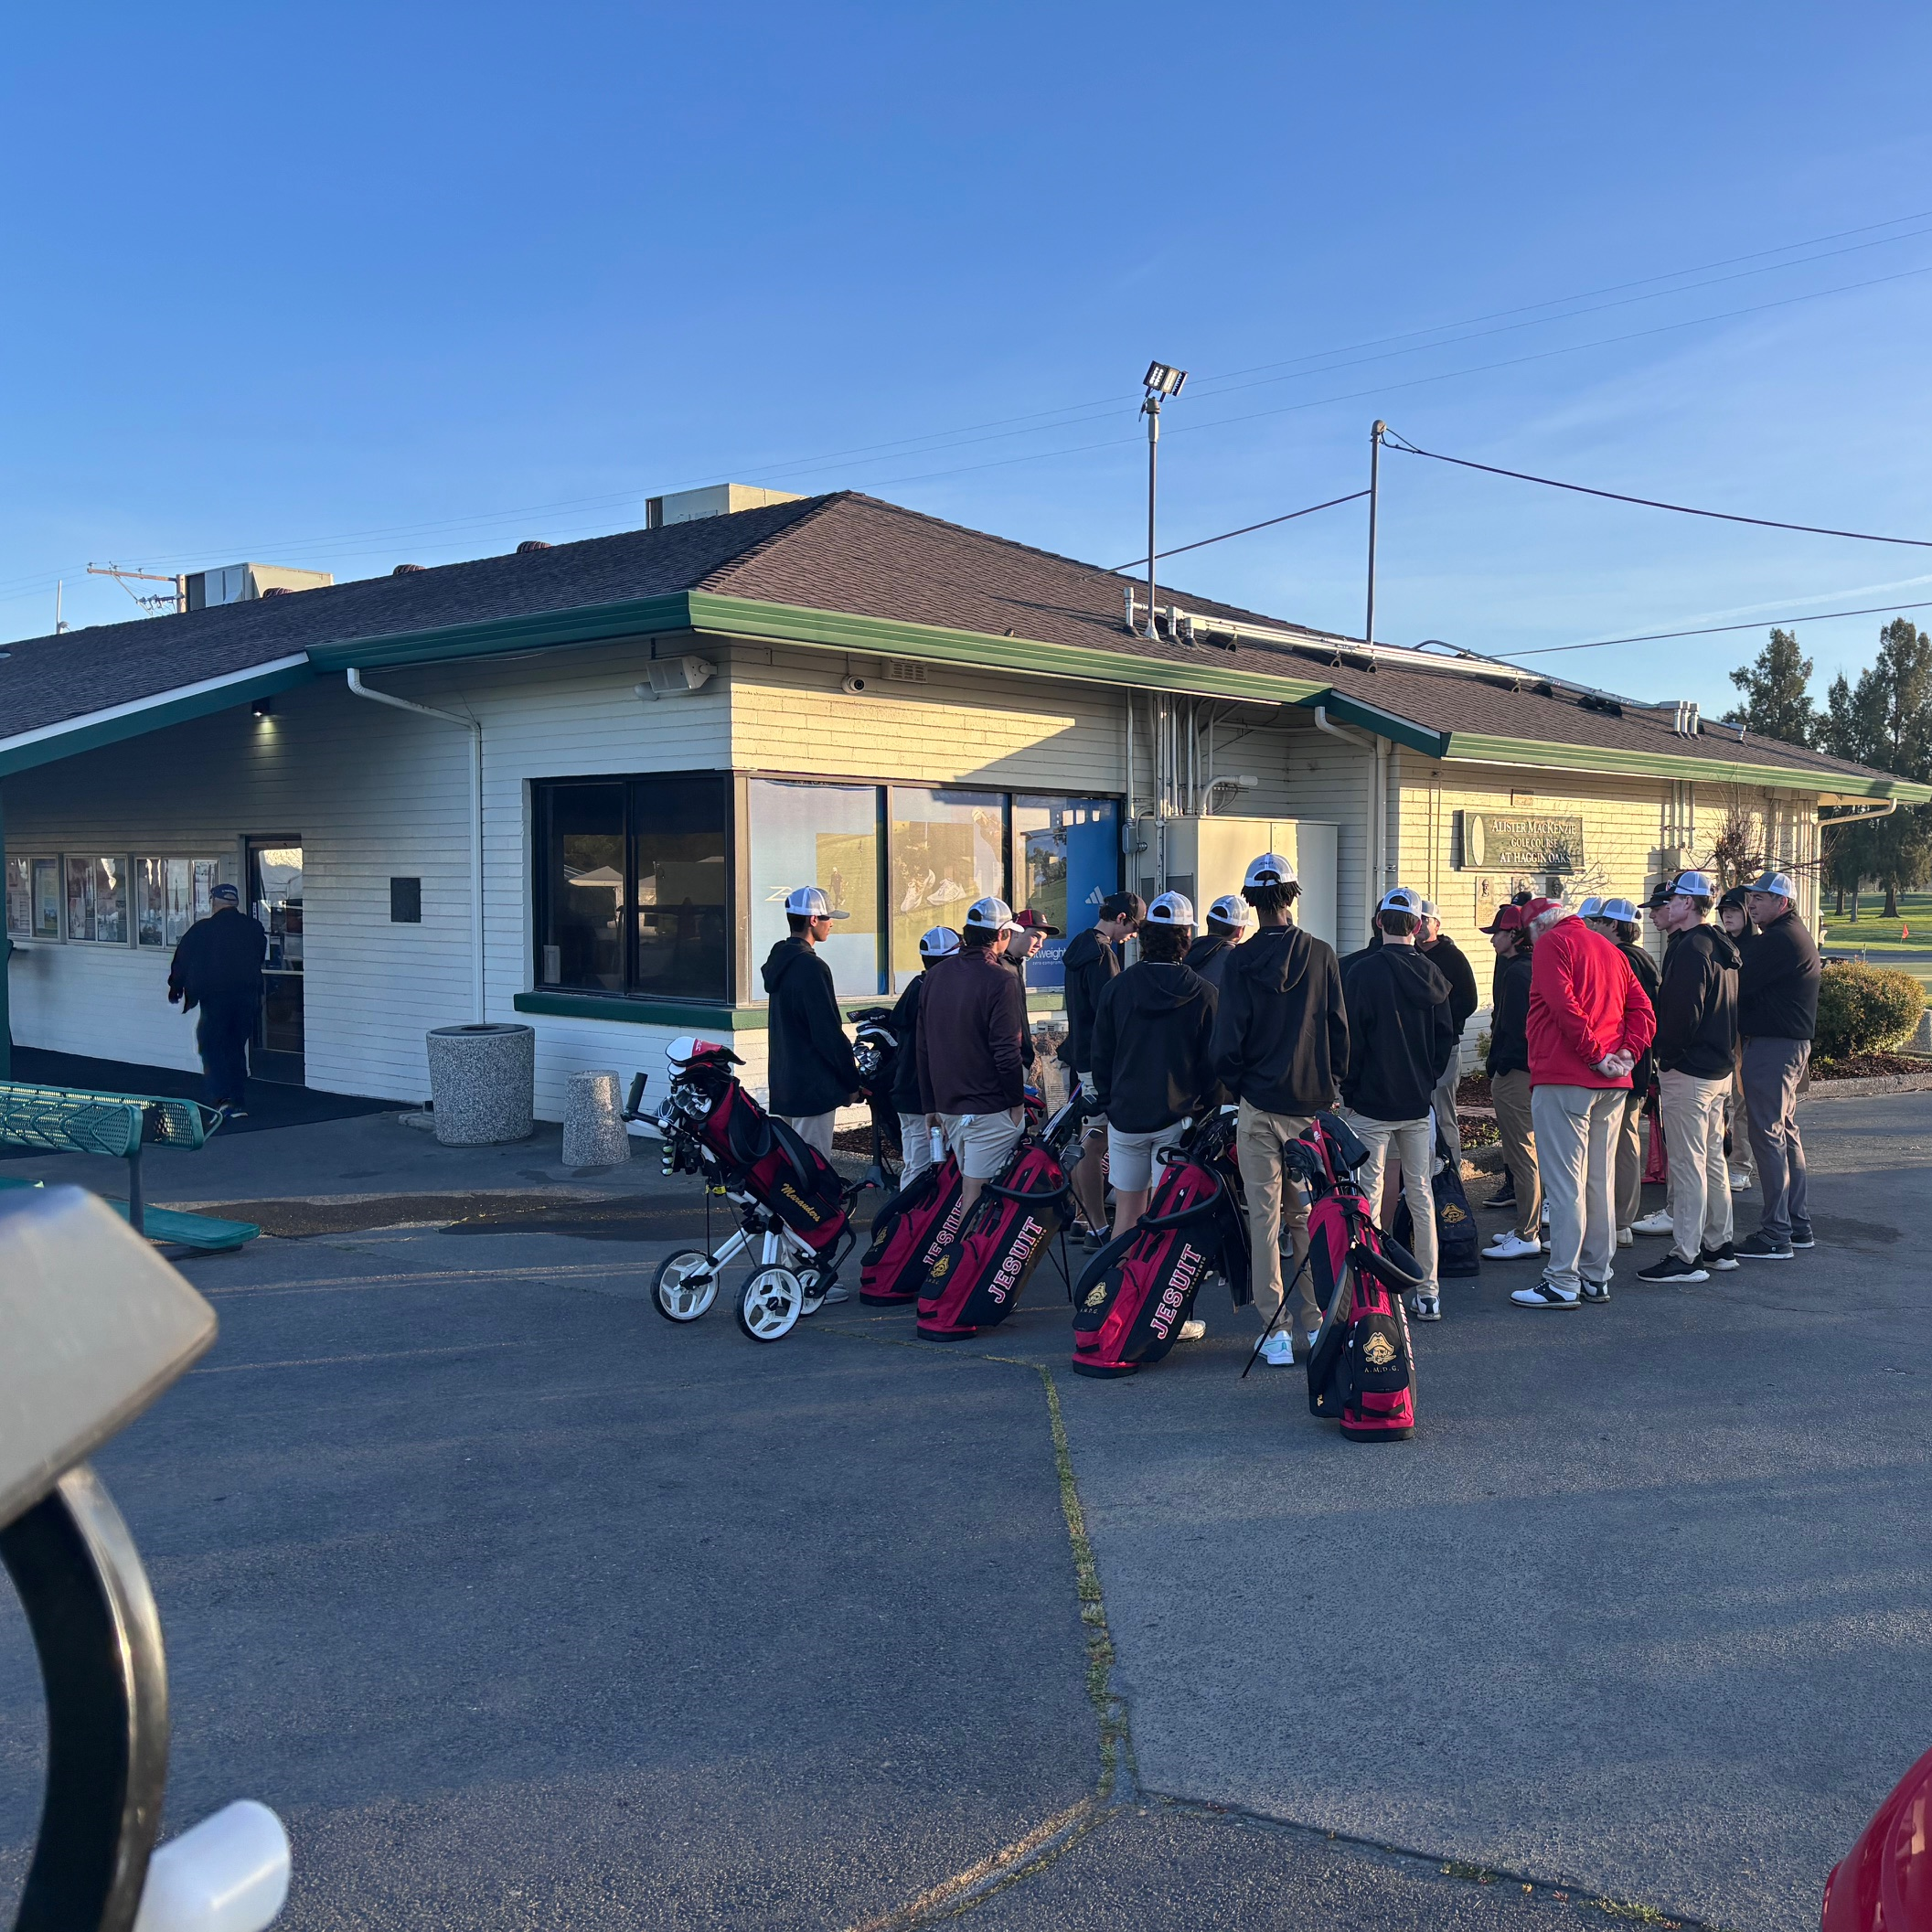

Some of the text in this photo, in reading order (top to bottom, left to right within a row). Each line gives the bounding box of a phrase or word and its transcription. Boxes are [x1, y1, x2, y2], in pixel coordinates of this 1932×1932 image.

[1491, 820, 1526, 833] ALISTER
[1510, 838, 1558, 849] GOLF COURSE
[1500, 852, 1572, 863] AT HAGGIN OAKS
[781, 1183, 821, 1222] Marauders
[987, 1215, 1043, 1304] JESUIT
[1149, 1243, 1202, 1340] JESUIT
